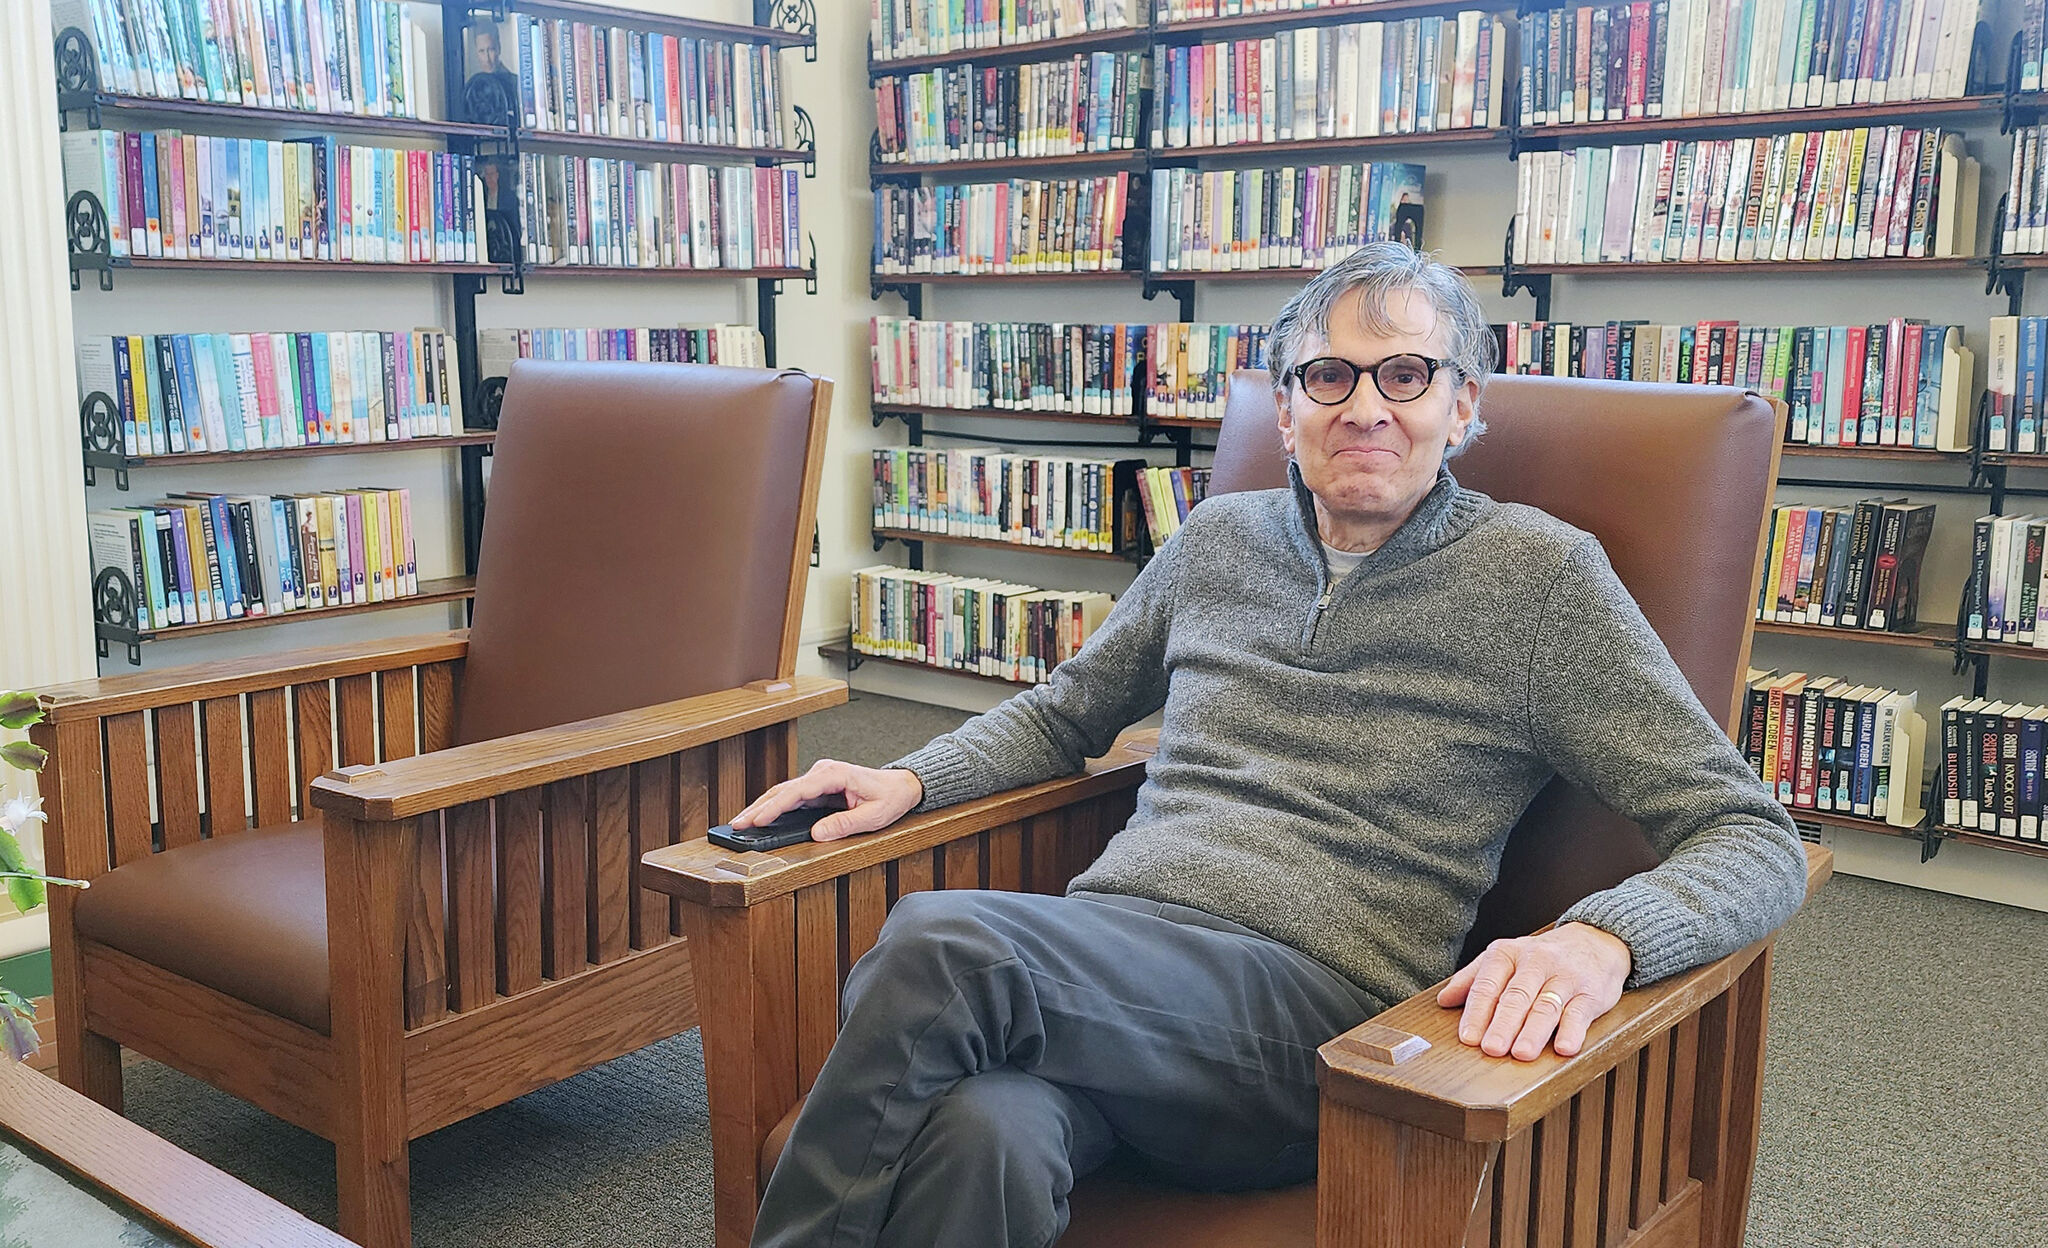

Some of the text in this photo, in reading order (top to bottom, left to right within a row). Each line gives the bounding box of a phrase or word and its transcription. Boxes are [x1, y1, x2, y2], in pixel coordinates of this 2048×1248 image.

[1747, 210, 1757, 227] PERS
[1606, 347, 1618, 378] CLANC
[1642, 359, 1652, 381] CLANC
[2021, 595, 2029, 617] PAINT
[1947, 753, 1958, 799] BLINDSID
